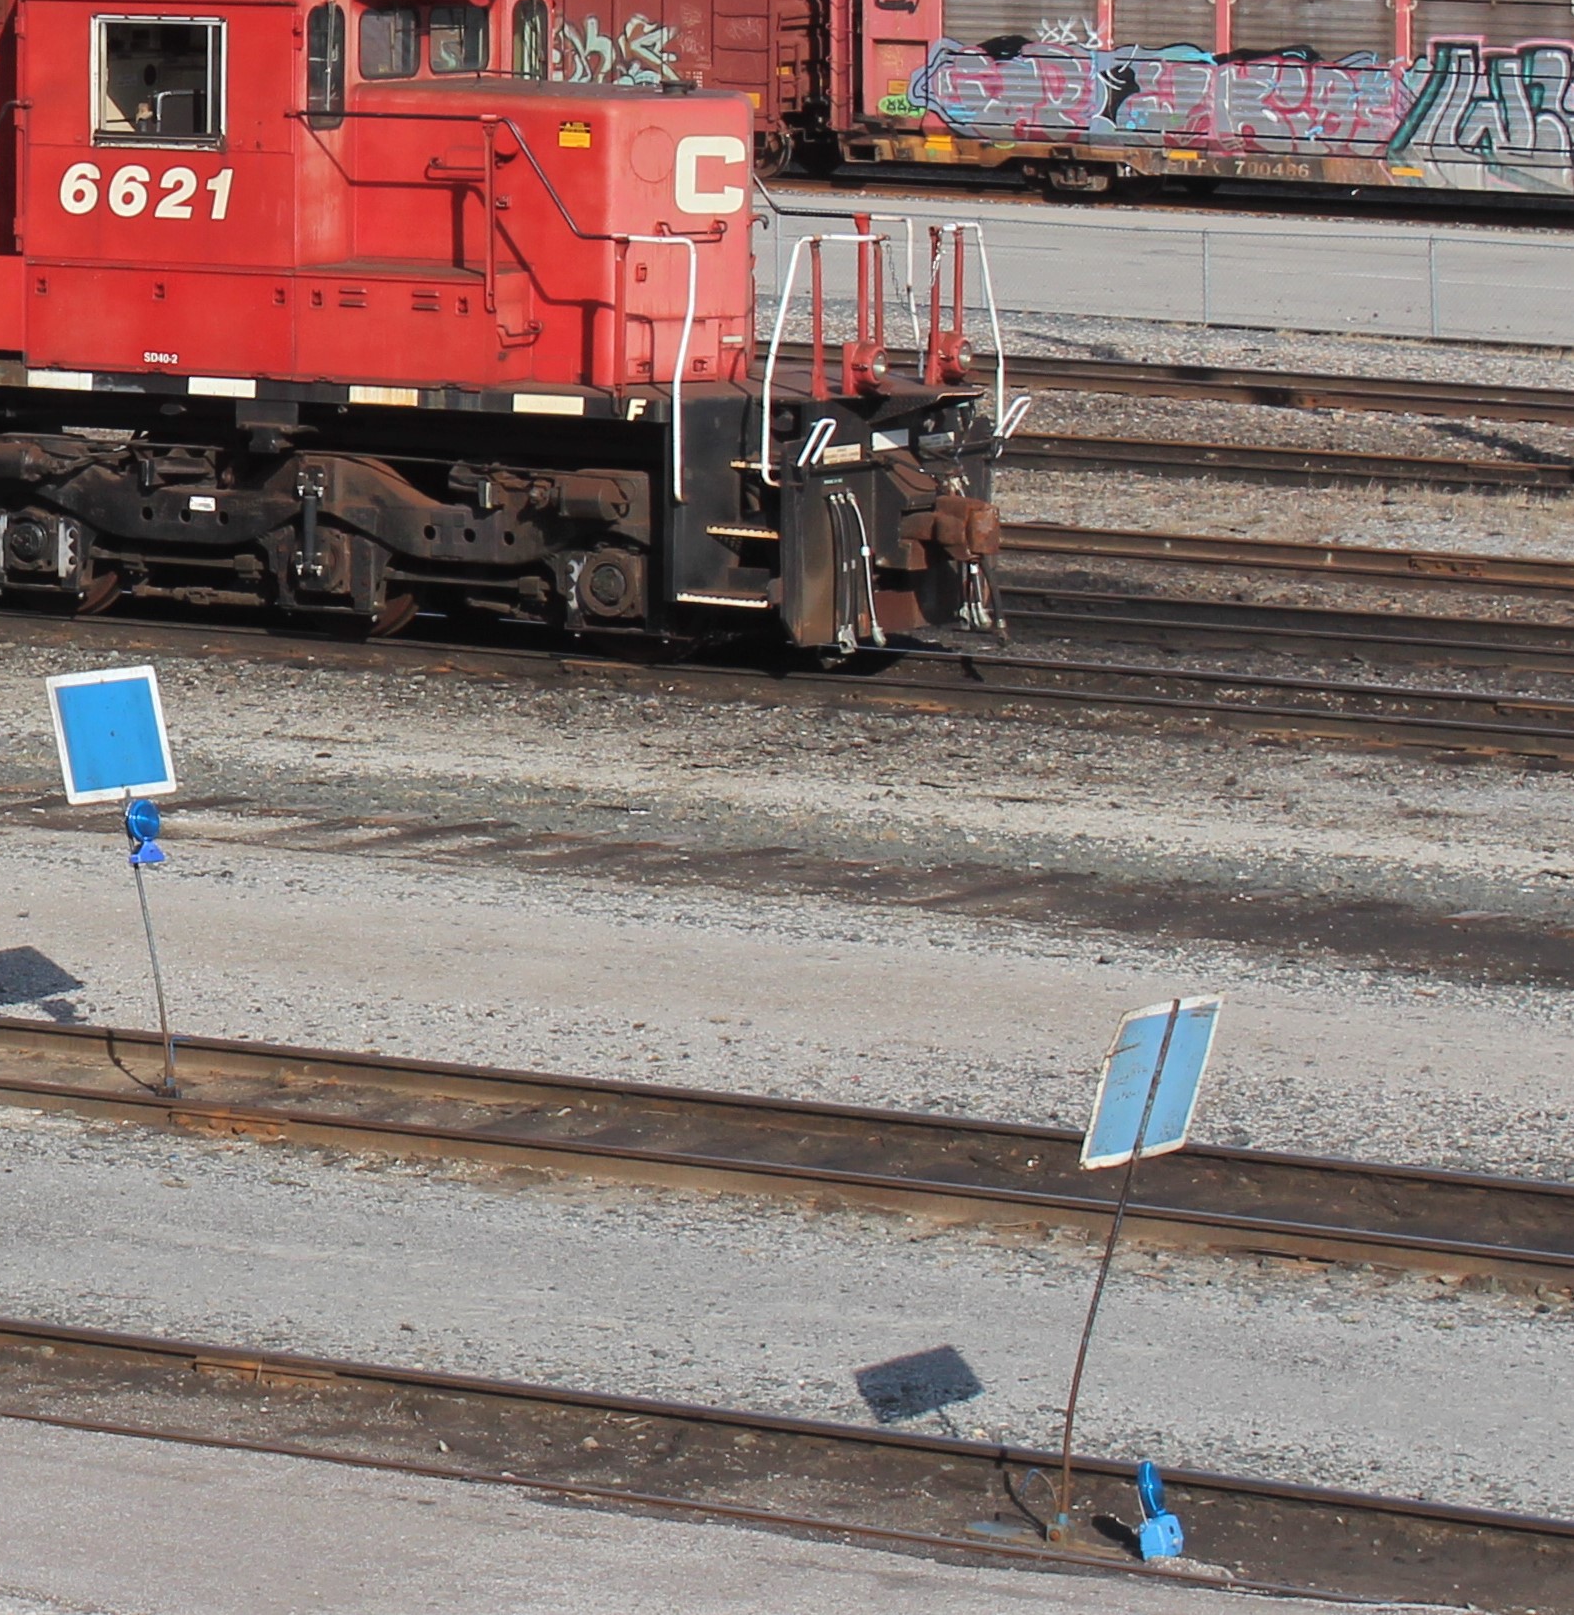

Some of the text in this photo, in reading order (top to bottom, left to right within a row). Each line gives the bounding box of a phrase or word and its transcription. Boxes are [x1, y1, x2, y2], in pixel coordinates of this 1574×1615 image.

[59, 162, 234, 220] 6621
[143, 351, 179, 364] SD40-2
[626, 398, 647, 421] F
